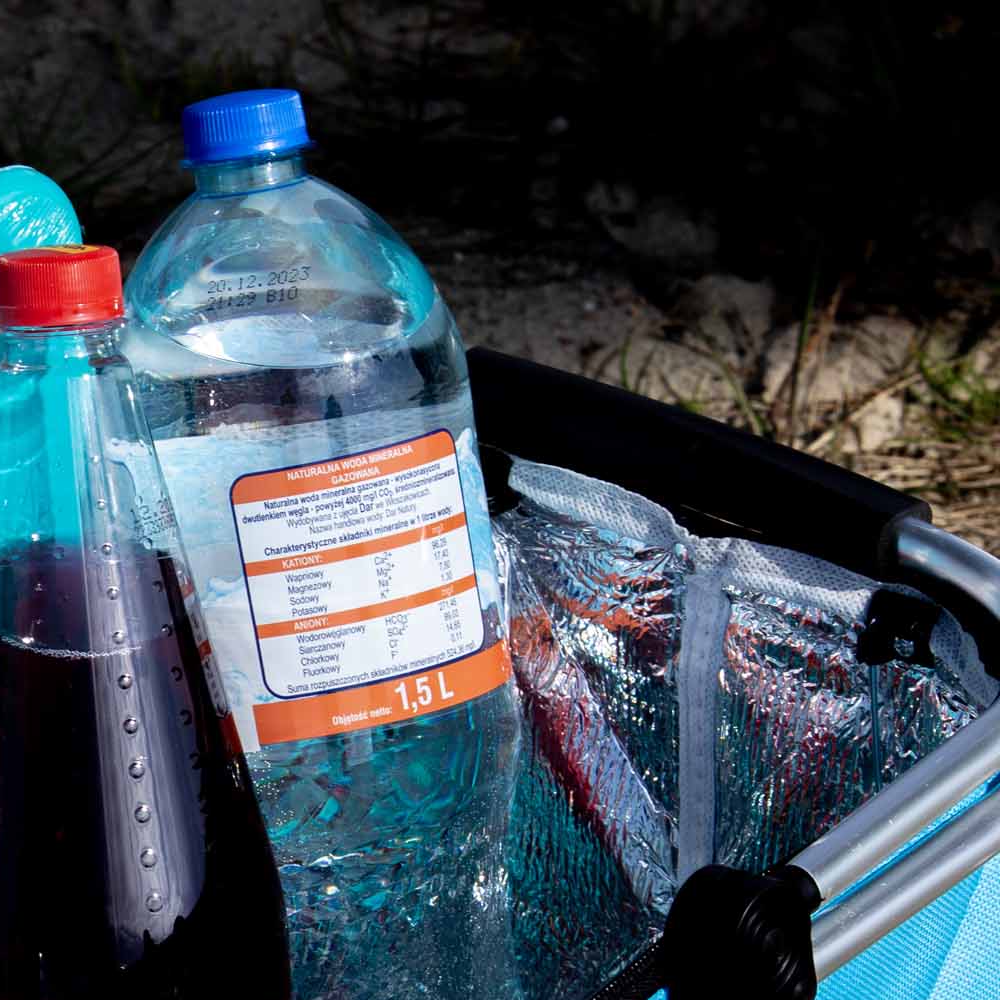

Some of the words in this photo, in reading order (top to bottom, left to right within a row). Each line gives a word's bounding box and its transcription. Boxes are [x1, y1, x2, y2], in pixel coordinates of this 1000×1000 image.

[207, 265, 311, 294] 20.12.2023
[266, 286, 299, 304] B10
[287, 463, 340, 481] NATURALNA
[342, 456, 369, 470] WODA
[369, 445, 414, 461] MINERALNA
[331, 466, 381, 484] GAZOWANA
[264, 497, 298, 510] Naturalna
[300, 493, 320, 505] woda
[321, 486, 356, 500] mineralna
[357, 478, 390, 493] gazowana
[242, 509, 287, 524] dwutlenkiem
[288, 504, 309, 517] węgla
[315, 500, 345, 513] powyżej
[286, 512, 332, 529] Wydobywana
[360, 502, 374, 514] Dar
[264, 535, 338, 556] Charakterystyczne
[339, 528, 373, 543] składniki
[374, 520, 409, 535] mineralne
[281, 553, 323, 569] KATIONY:
[285, 569, 325, 584] Wapniowy
[287, 581, 332, 595] Magnezowy
[289, 594, 320, 606] Sodowy
[291, 604, 328, 617] Potasowy
[293, 615, 329, 631] ANIONY:
[296, 624, 367, 644] Wodorowęglanowy
[300, 653, 340, 667] Chlorkowy
[302, 664, 341, 678] Fluorkowy
[287, 682, 309, 694] Suma
[310, 672, 370, 691] rozpuszczonych
[394, 675, 432, 713] 1,5
[437, 671, 454, 700] L
[332, 708, 369, 726] Objętość
[370, 706, 393, 719] netto:
